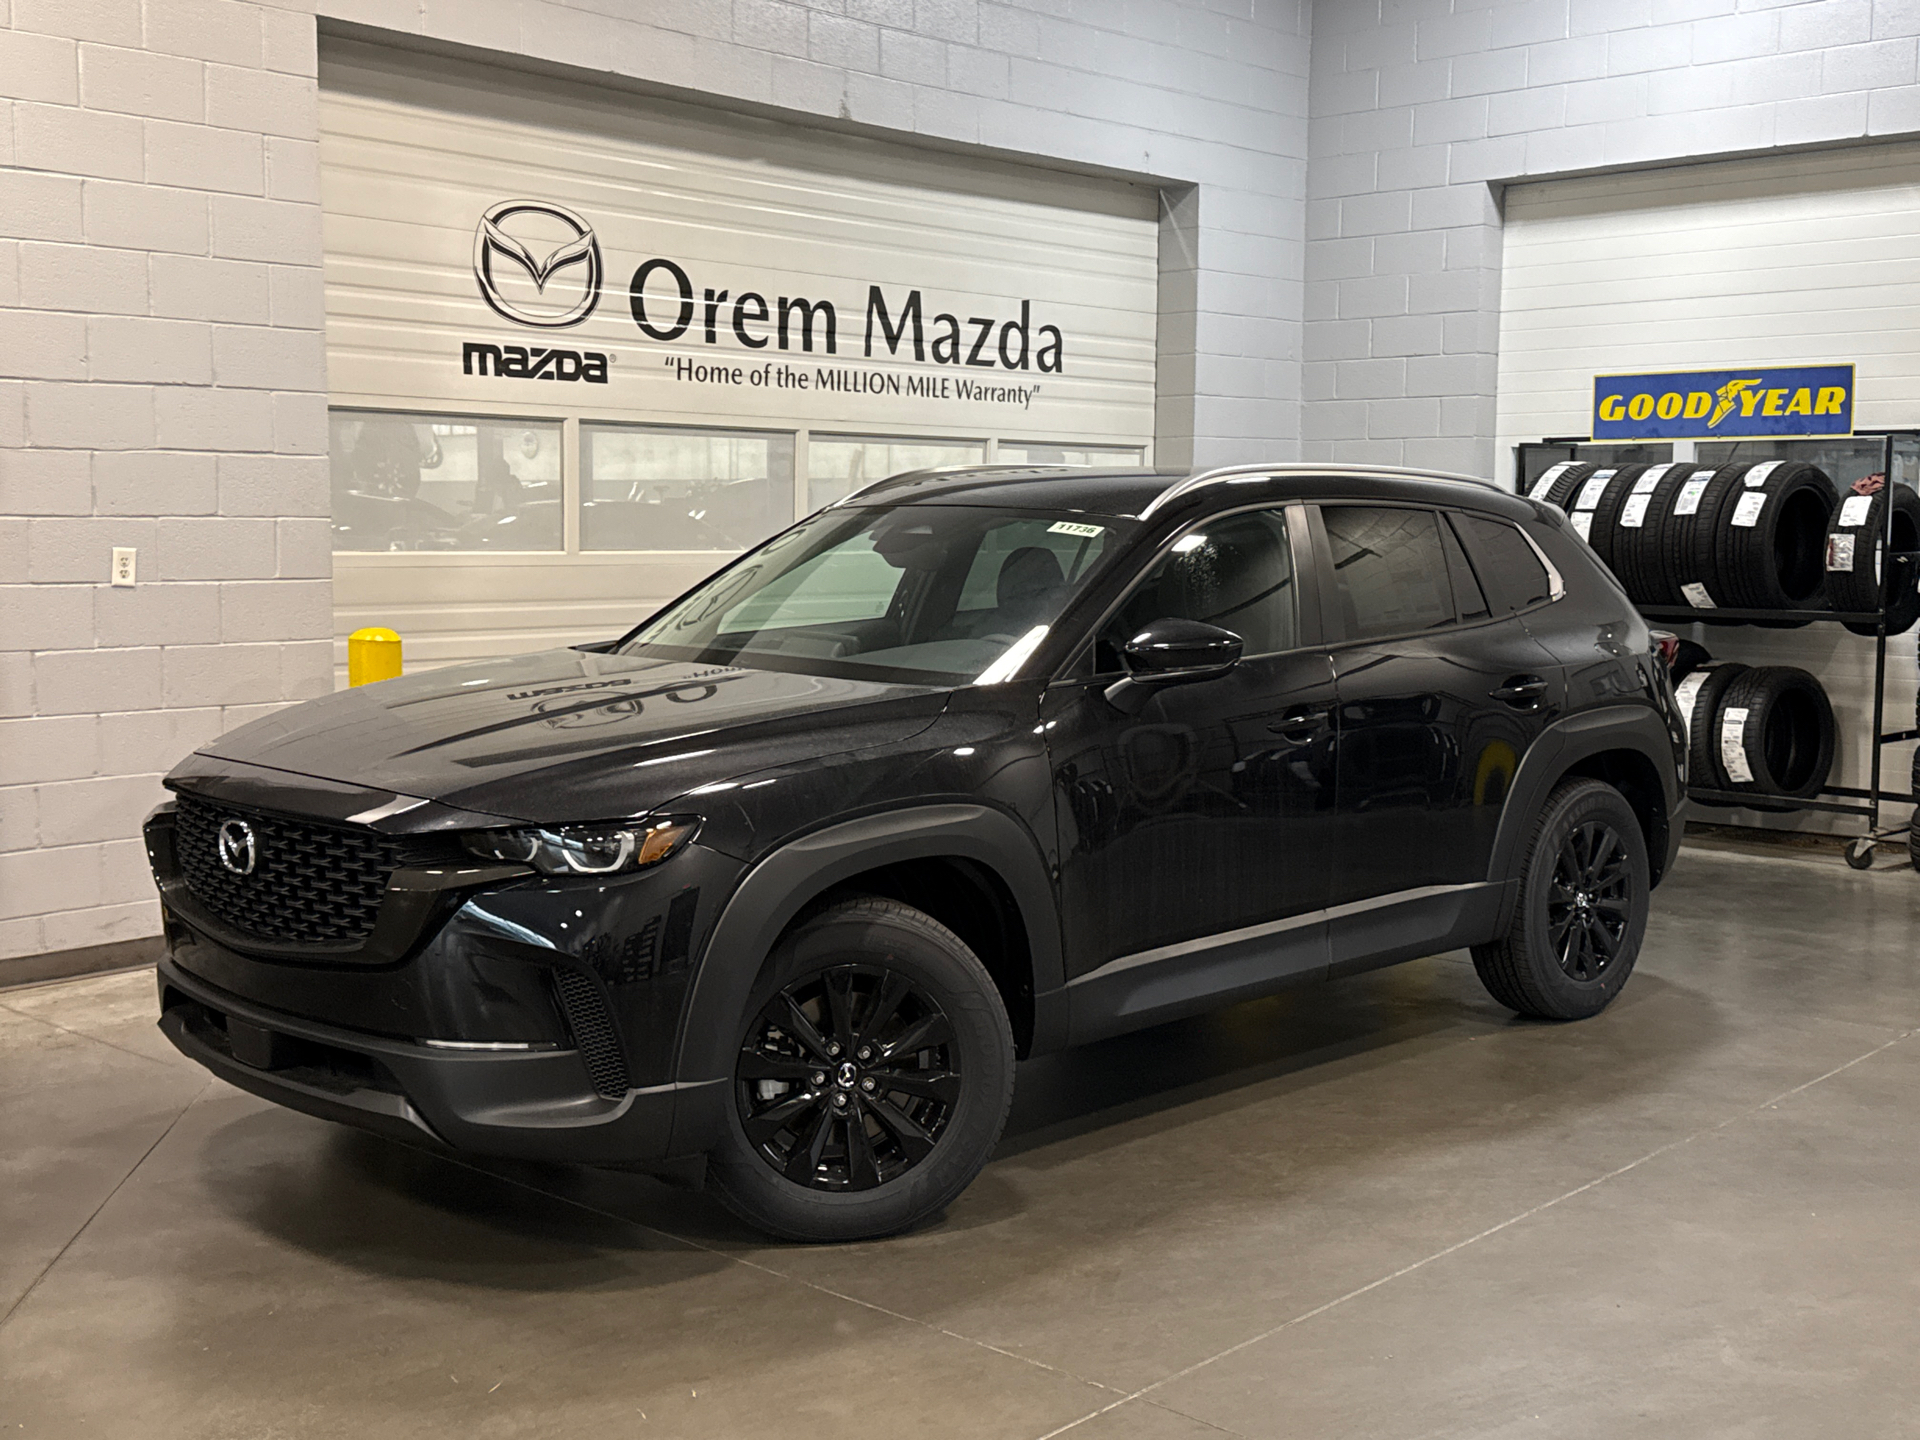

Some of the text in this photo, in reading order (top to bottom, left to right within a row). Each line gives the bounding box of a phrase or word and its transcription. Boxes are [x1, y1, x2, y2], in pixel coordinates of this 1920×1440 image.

[629, 258, 1064, 374] Orem Mazda
[749, 363, 773, 388] of
[775, 366, 809, 390] the
[815, 368, 900, 397] MILLION
[906, 375, 950, 400] MILE
